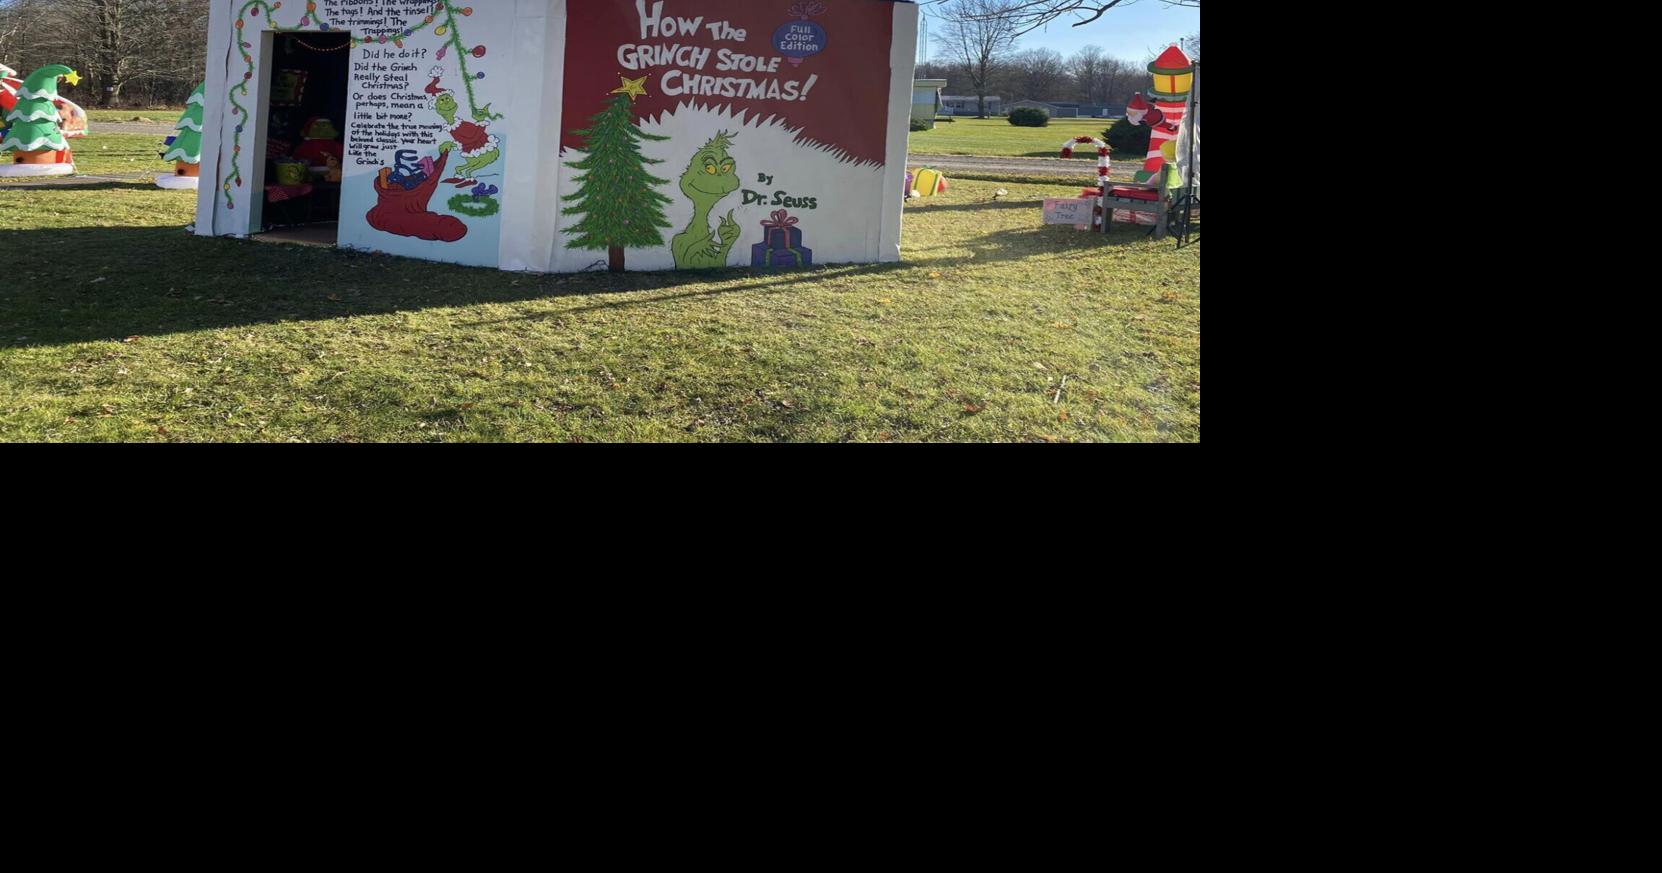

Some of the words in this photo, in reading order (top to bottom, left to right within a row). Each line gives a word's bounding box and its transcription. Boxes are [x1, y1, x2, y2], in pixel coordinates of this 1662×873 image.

[325, 8, 340, 16] The
[341, 7, 364, 17] tags!
[367, 7, 384, 16] And
[385, 7, 401, 16] the
[329, 18, 345, 26] The
[347, 16, 388, 28] trimmings!
[390, 17, 408, 26] The
[360, 27, 404, 36] Trappings!
[780, 41, 818, 51] Edition
[363, 49, 380, 59] Did
[384, 49, 398, 59] he
[399, 49, 410, 58] do
[411, 49, 427, 59] it?
[617, 42, 711, 70] GRINCH
[715, 48, 782, 73] STOLE
[354, 63, 369, 71] Did
[372, 62, 387, 71] the
[390, 63, 418, 72] Grinch
[354, 73, 380, 84] Really
[361, 82, 410, 91] Christmas?
[660, 69, 819, 101] CHRISTMAS!
[367, 92, 387, 100] does
[356, 101, 389, 110] perhaps,
[353, 112, 373, 120] little
[376, 112, 388, 120] bit
[387, 122, 400, 130] the
[361, 129, 373, 137] the
[374, 130, 401, 139] holidays
[402, 130, 419, 138] with
[381, 143, 398, 151] just
[757, 172, 774, 186] By
[741, 189, 768, 206] Dr.
[771, 190, 818, 210] Seuss
